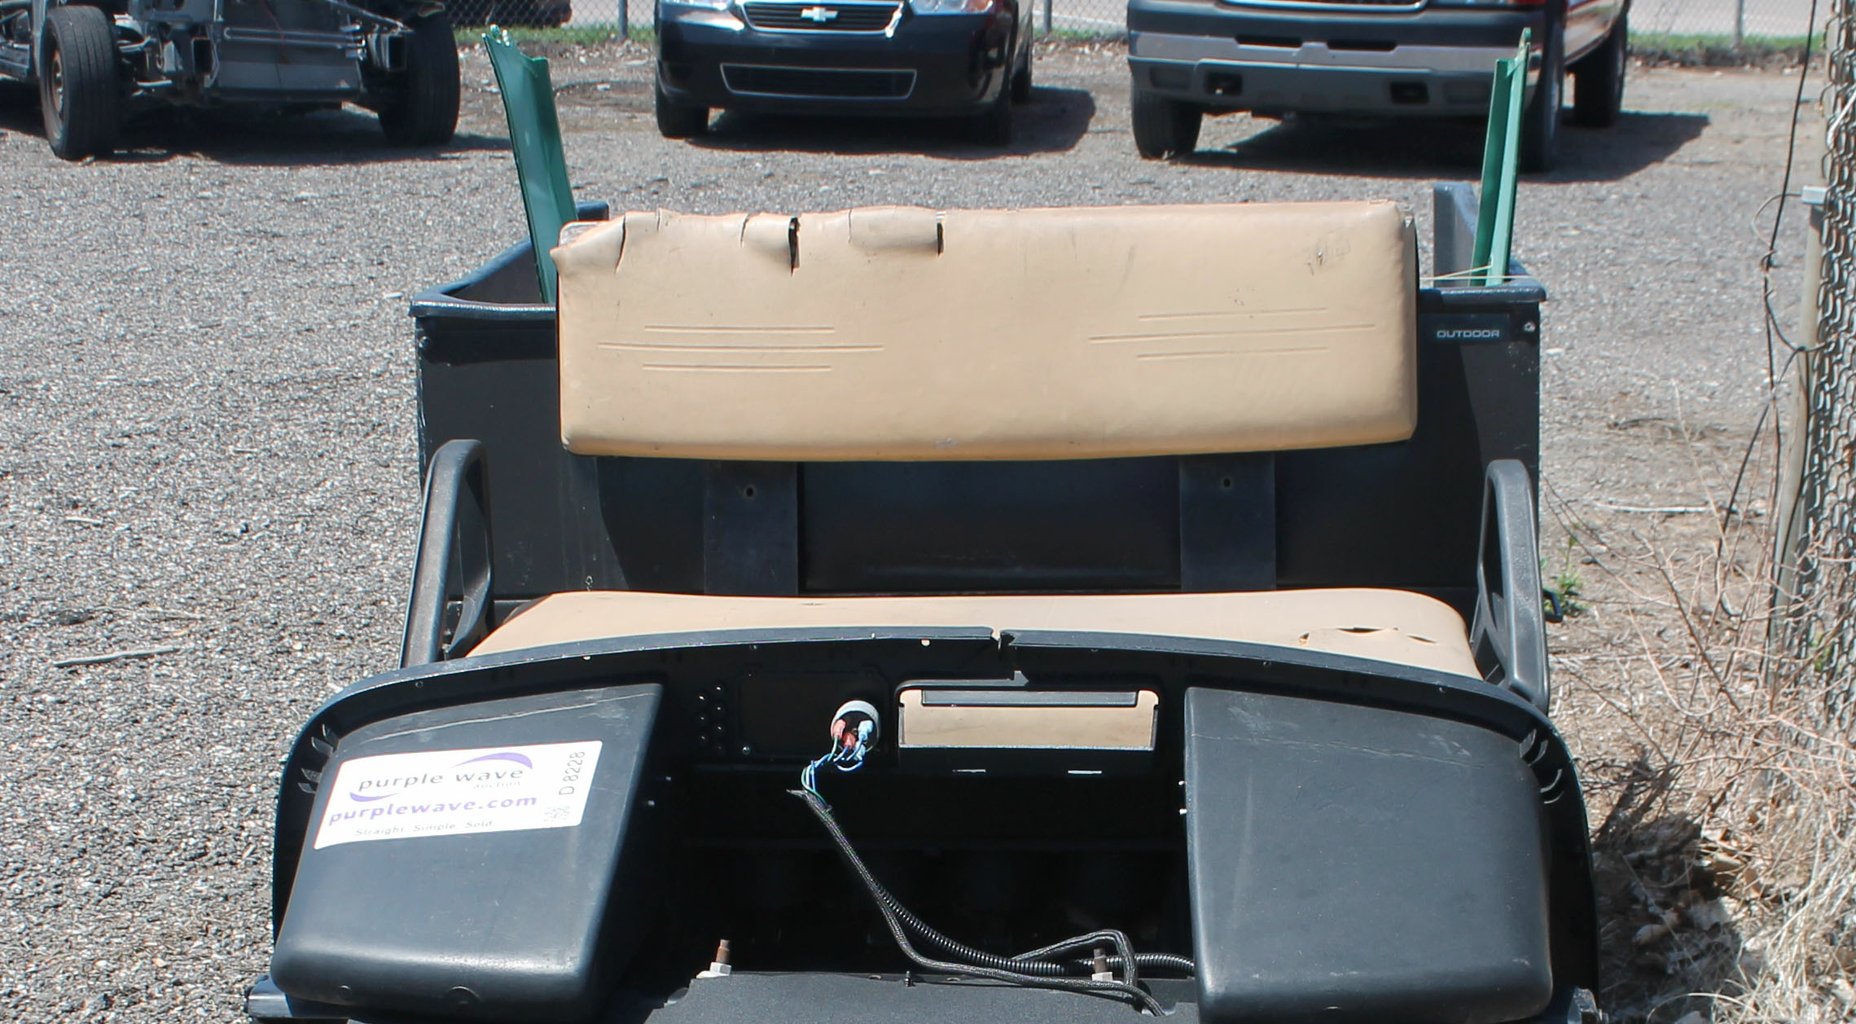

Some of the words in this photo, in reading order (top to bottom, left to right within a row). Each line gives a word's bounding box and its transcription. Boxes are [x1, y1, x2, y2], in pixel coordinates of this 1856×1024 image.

[1436, 329, 1500, 338] OUTDOOR
[357, 769, 444, 792] purple
[455, 769, 523, 782] wave
[328, 795, 538, 826] purplewave.com
